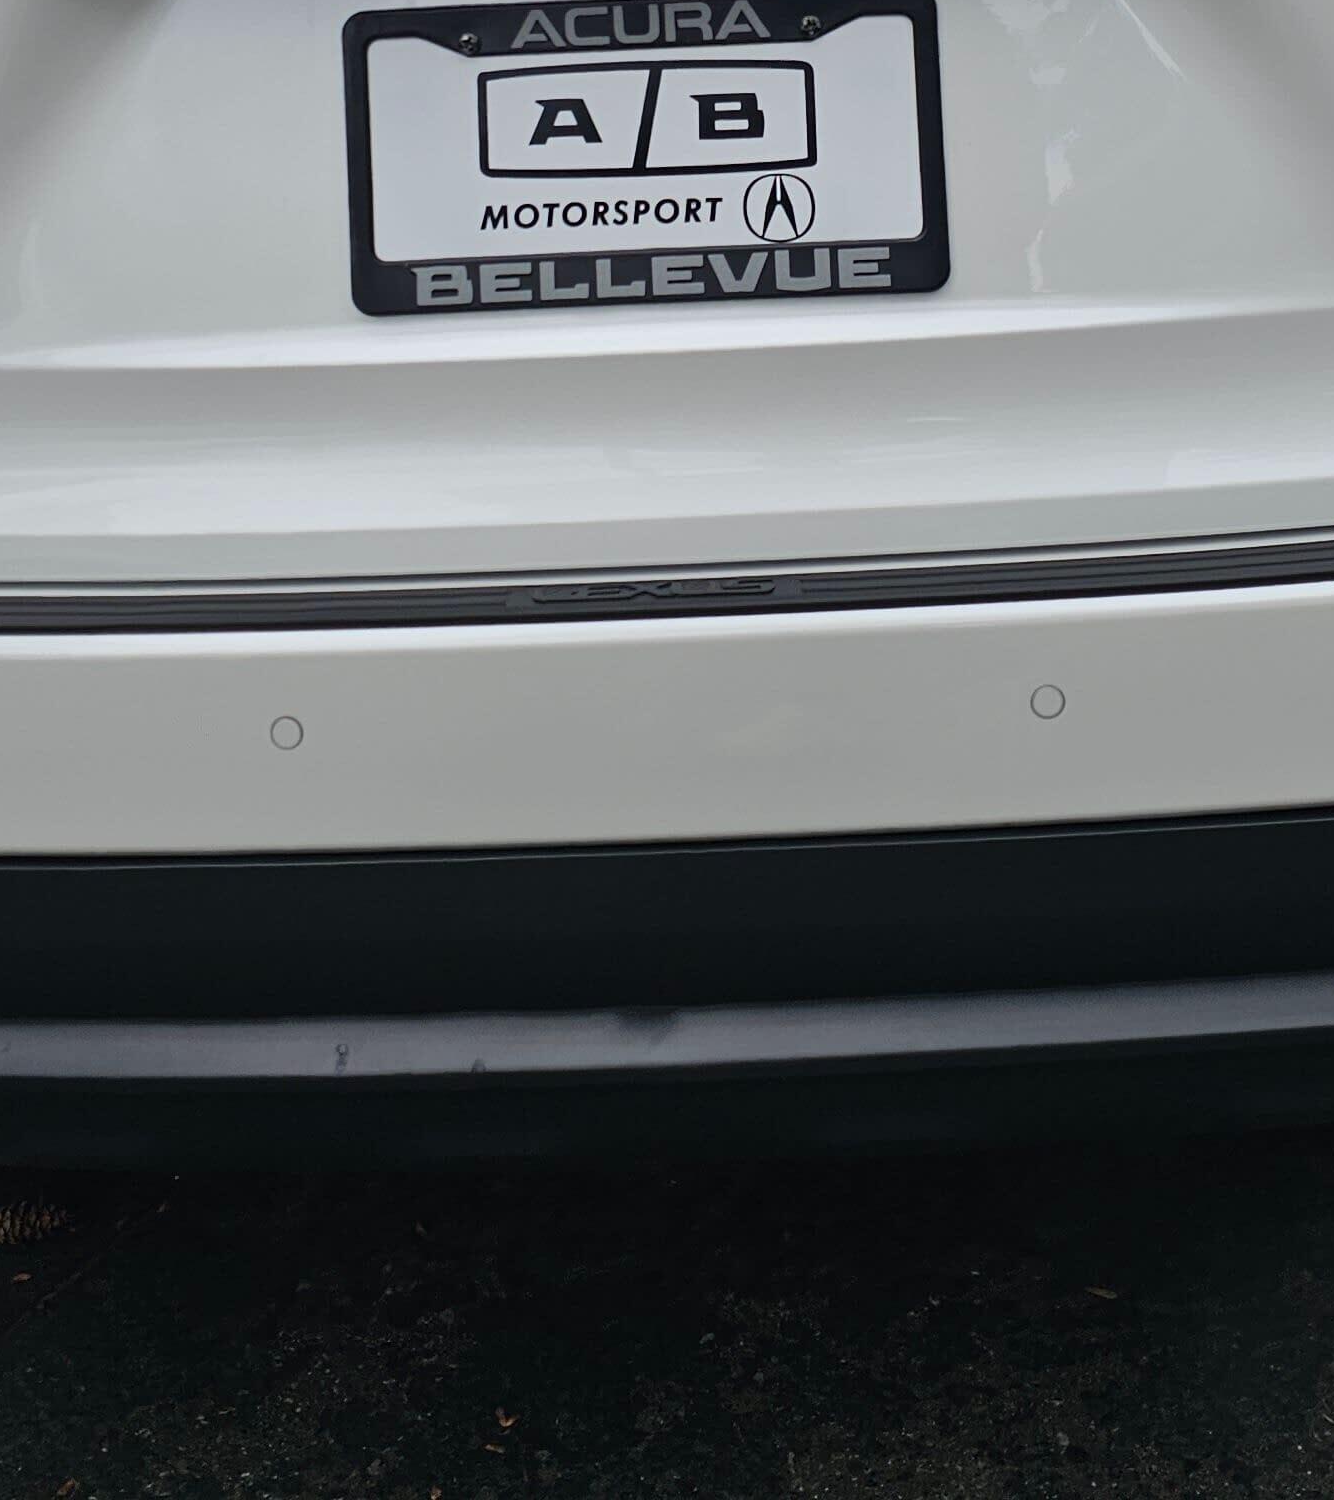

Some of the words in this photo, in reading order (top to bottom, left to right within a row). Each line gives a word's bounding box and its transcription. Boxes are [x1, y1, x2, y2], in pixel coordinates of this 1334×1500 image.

[511, 0, 771, 50] ACURA
[528, 98, 603, 145] A
[689, 92, 765, 140] B
[480, 197, 723, 231] MOTORSPORT
[410, 246, 892, 307] BELLEVUE
